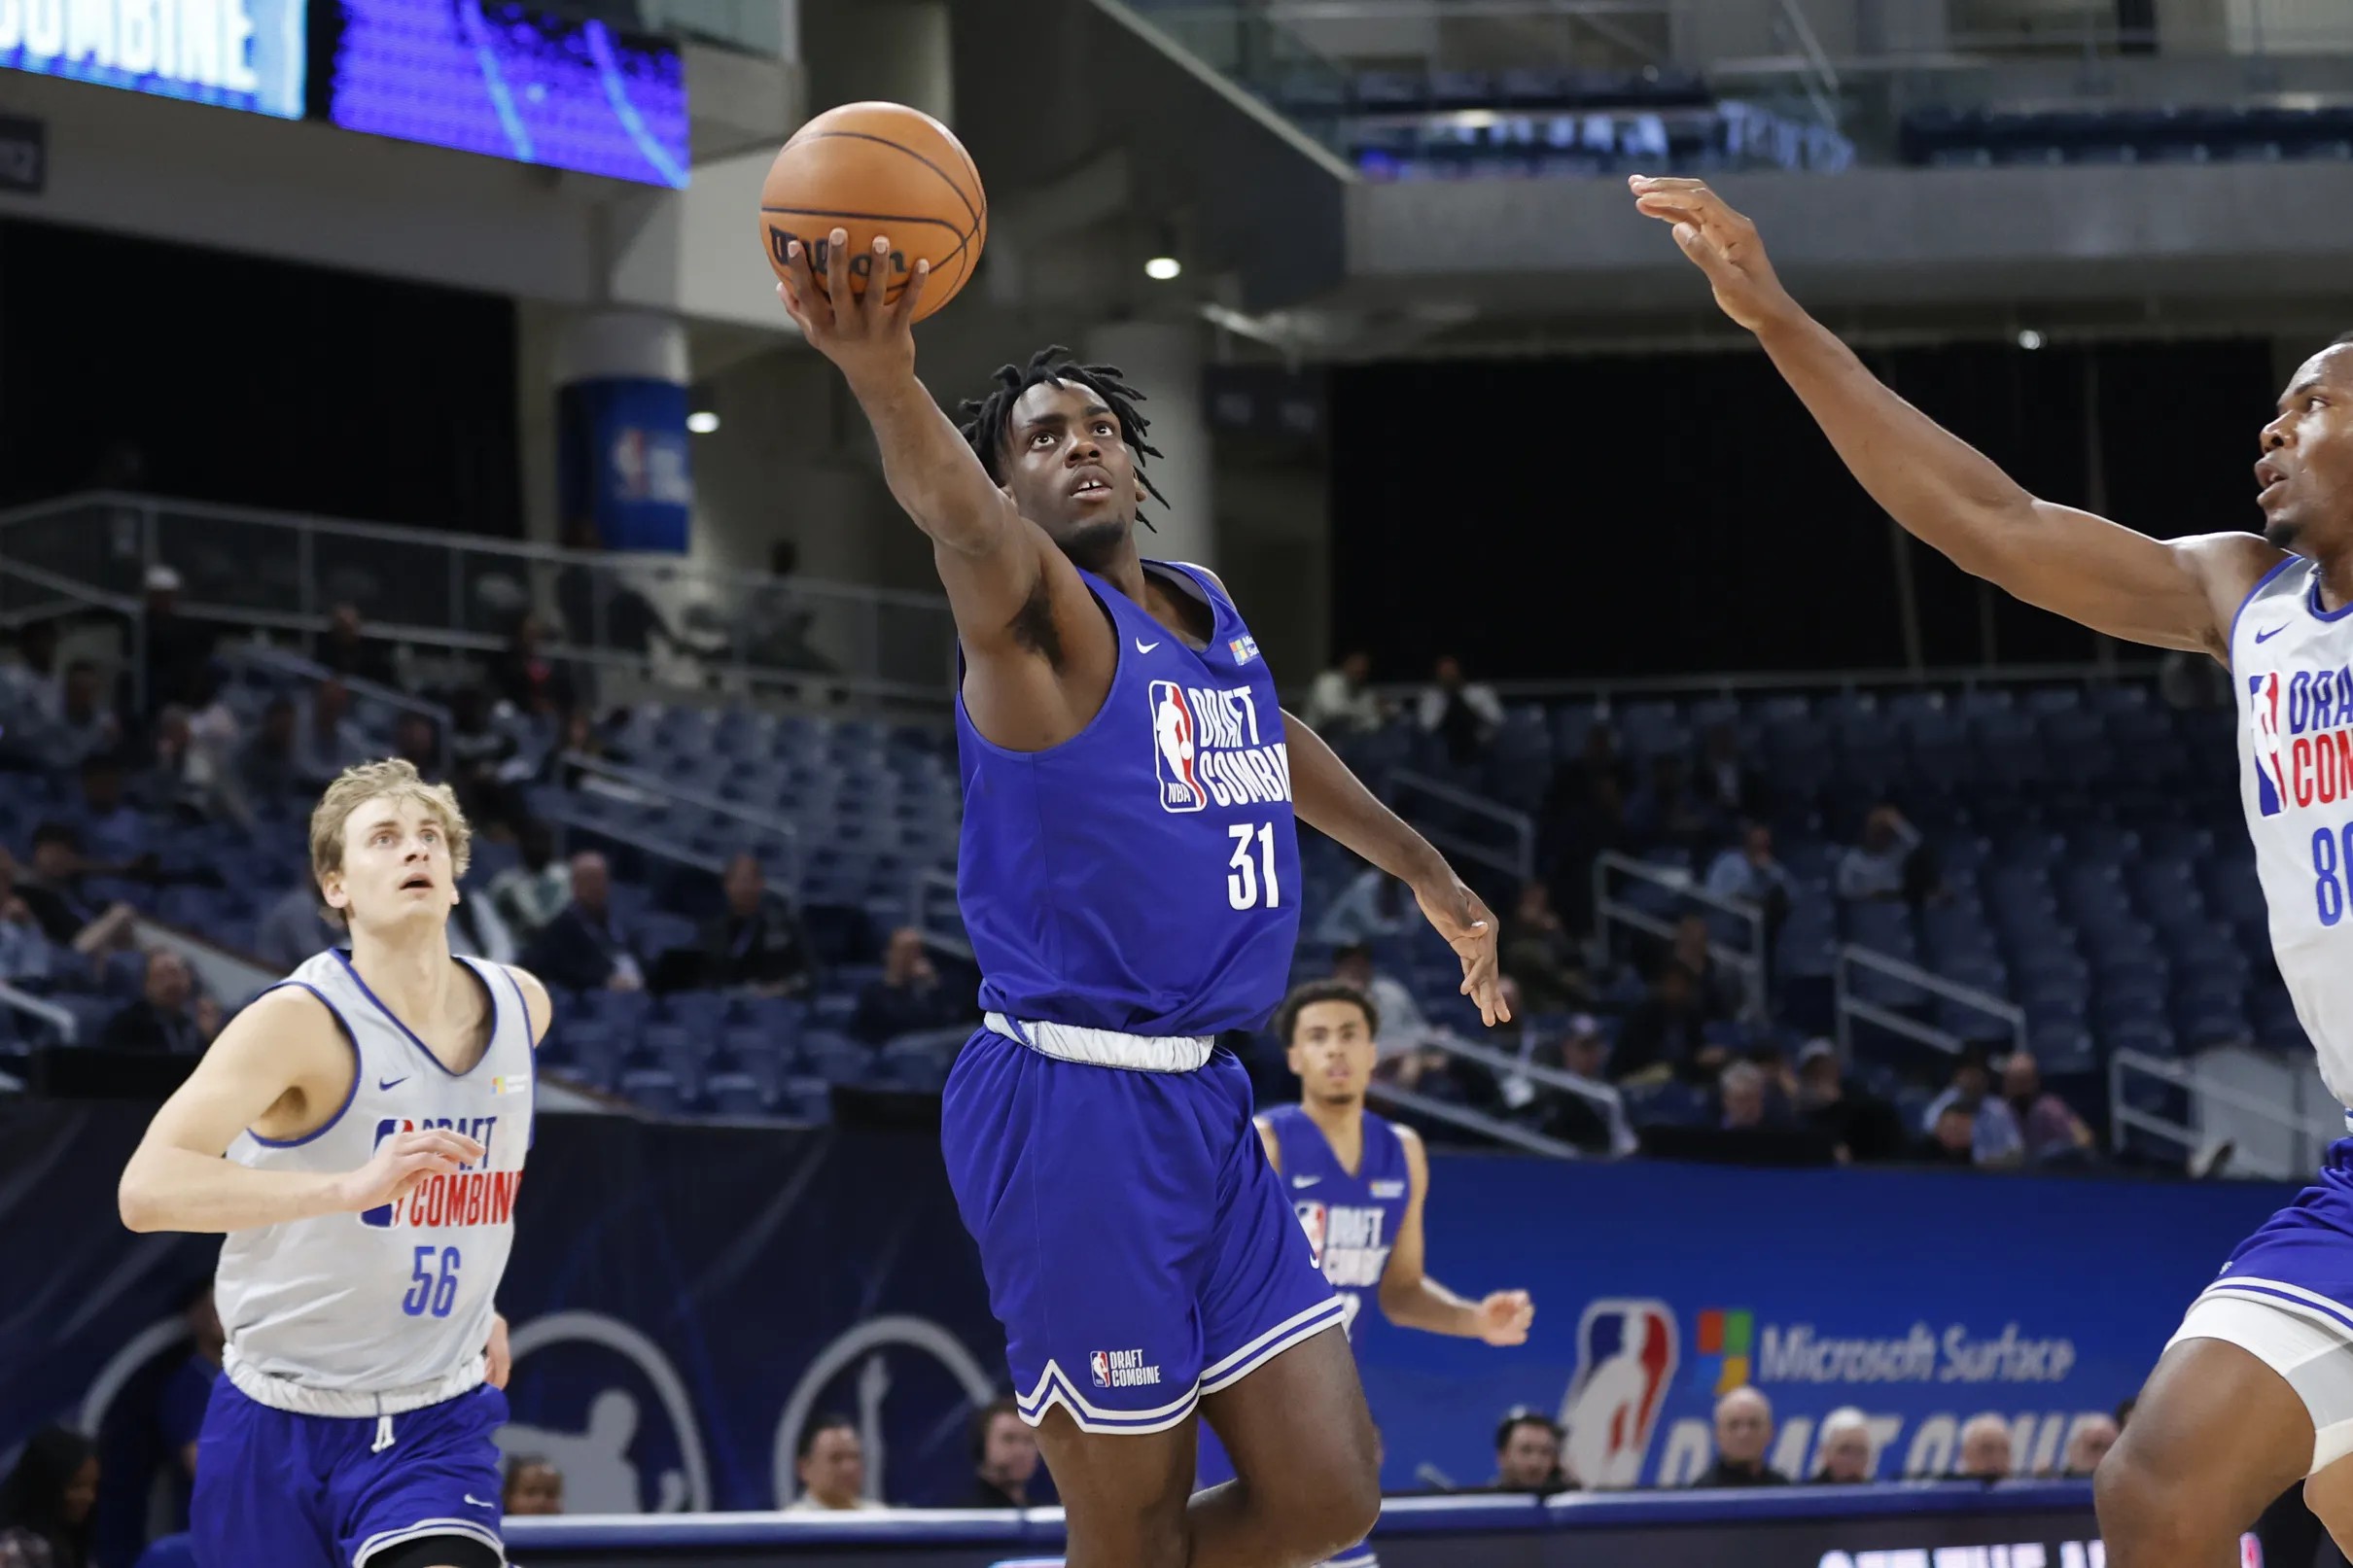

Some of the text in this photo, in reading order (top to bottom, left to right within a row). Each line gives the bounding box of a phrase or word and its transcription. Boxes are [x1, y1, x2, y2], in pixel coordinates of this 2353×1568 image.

[1187, 685, 1260, 749] DRAFT
[1168, 783, 1191, 804] NBA
[1227, 821, 1280, 911] 31
[402, 1246, 461, 1318] 56
[1108, 1348, 1143, 1370] DRAFT
[1111, 1365, 1161, 1387] COMBINE
[1760, 1321, 2077, 1383] Microsoft Surface
